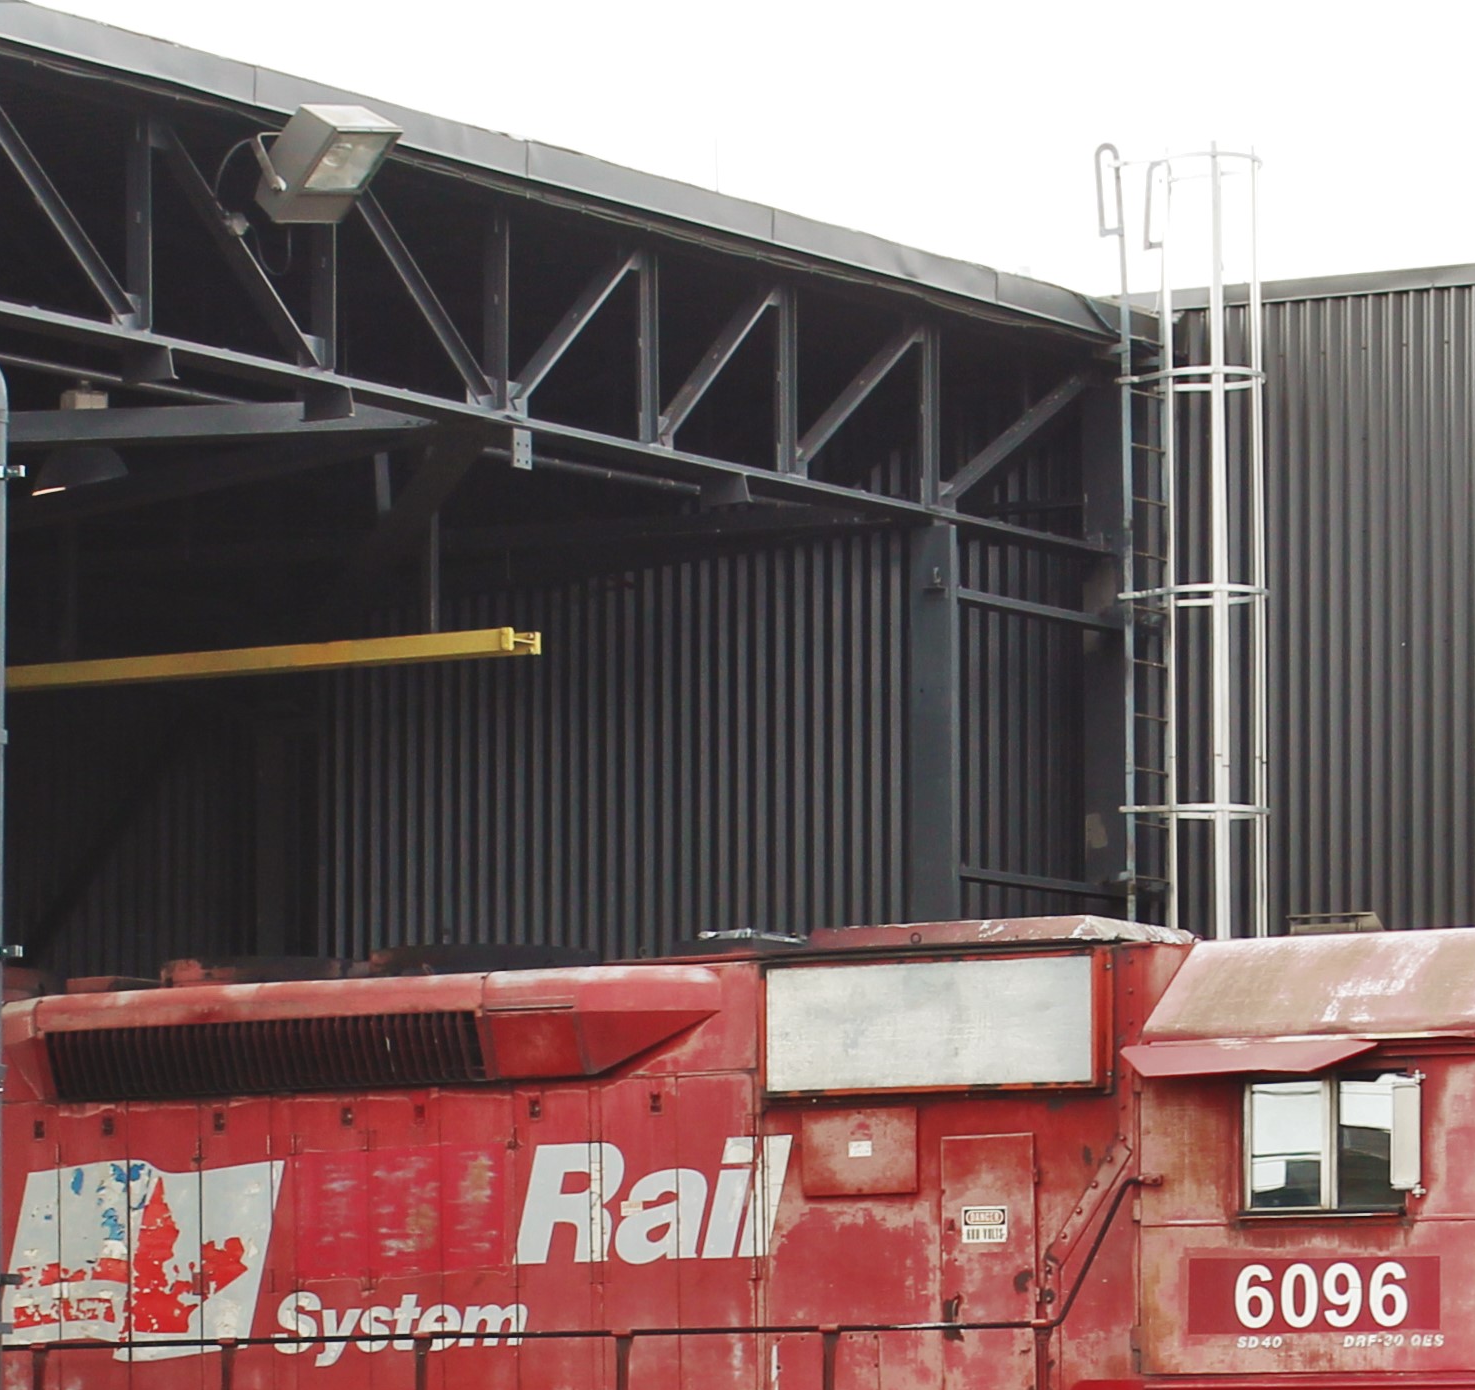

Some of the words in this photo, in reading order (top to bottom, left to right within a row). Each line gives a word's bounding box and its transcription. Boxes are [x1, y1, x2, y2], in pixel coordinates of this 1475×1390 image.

[512, 1134, 793, 1265] Rail
[270, 1293, 529, 1367] System
[1233, 1261, 1409, 1329] 6096
